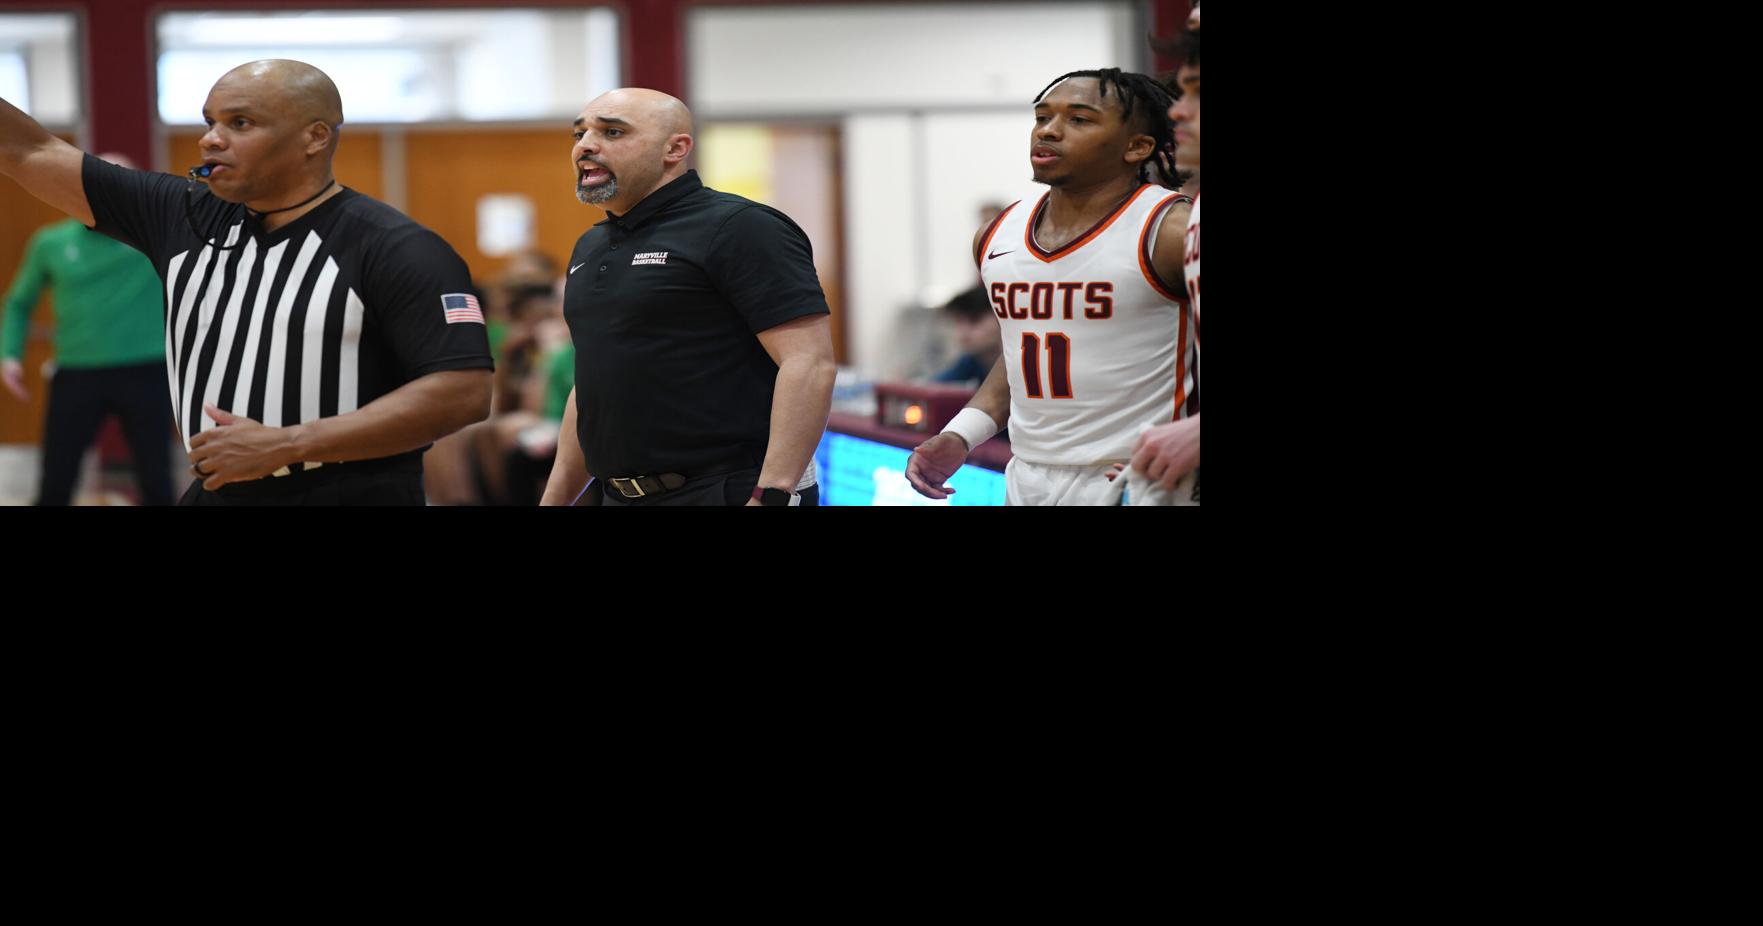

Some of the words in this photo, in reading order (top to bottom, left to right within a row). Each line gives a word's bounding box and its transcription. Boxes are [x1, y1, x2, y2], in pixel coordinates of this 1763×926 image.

[631, 258, 667, 266] BASKETBALL
[633, 252, 669, 260] MARYVILLE
[991, 282, 1113, 320] SCOTS
[1021, 332, 1074, 399] 11
